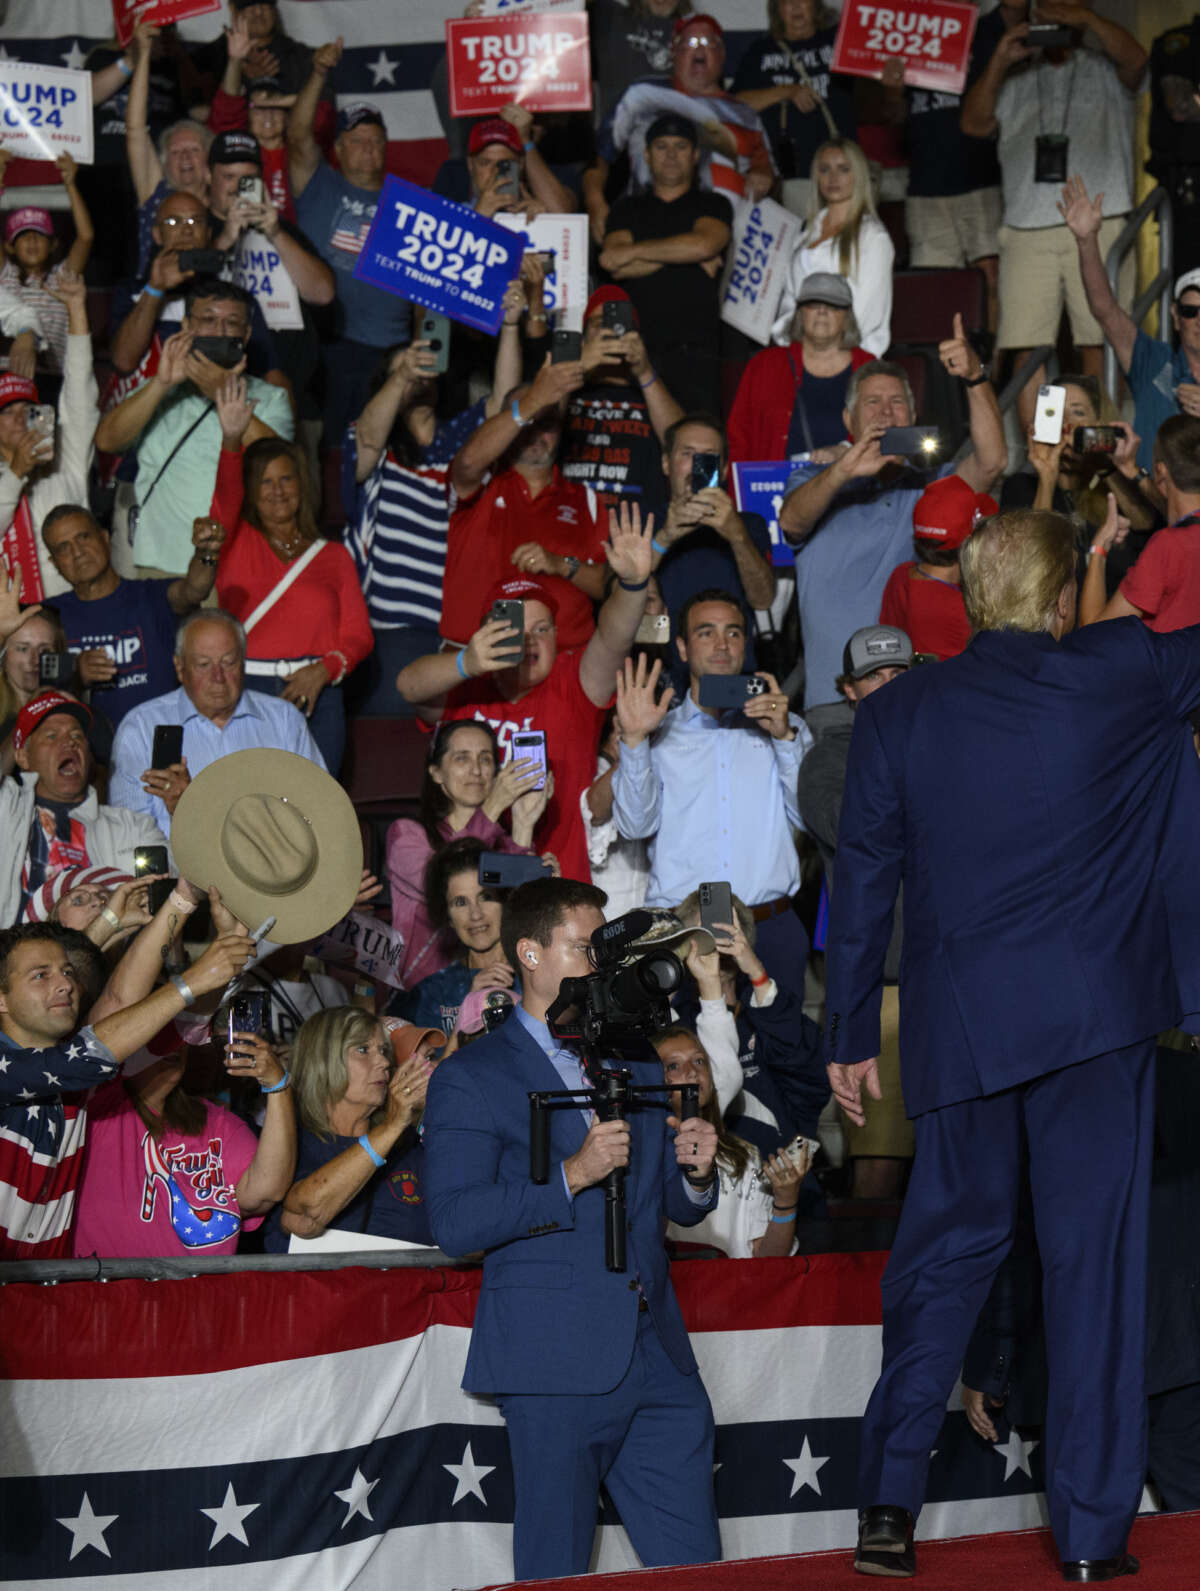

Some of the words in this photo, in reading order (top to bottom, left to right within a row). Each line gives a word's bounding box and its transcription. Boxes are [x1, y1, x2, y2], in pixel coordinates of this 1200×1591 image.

[857, 5, 961, 38] TRUMP
[460, 32, 574, 61] TRUMP
[865, 29, 942, 58] 2024
[477, 55, 560, 84] 2024
[0, 82, 77, 107] UMP
[3, 106, 64, 128] 024
[394, 201, 509, 268] TRUMP
[241, 251, 280, 270] UMP
[397, 235, 485, 290] 2024
[724, 207, 761, 304] TRUMP
[743, 231, 773, 304] 2024
[374, 252, 402, 272] TEXT
[404, 266, 442, 288] TRUMP
[445, 282, 460, 297] TO
